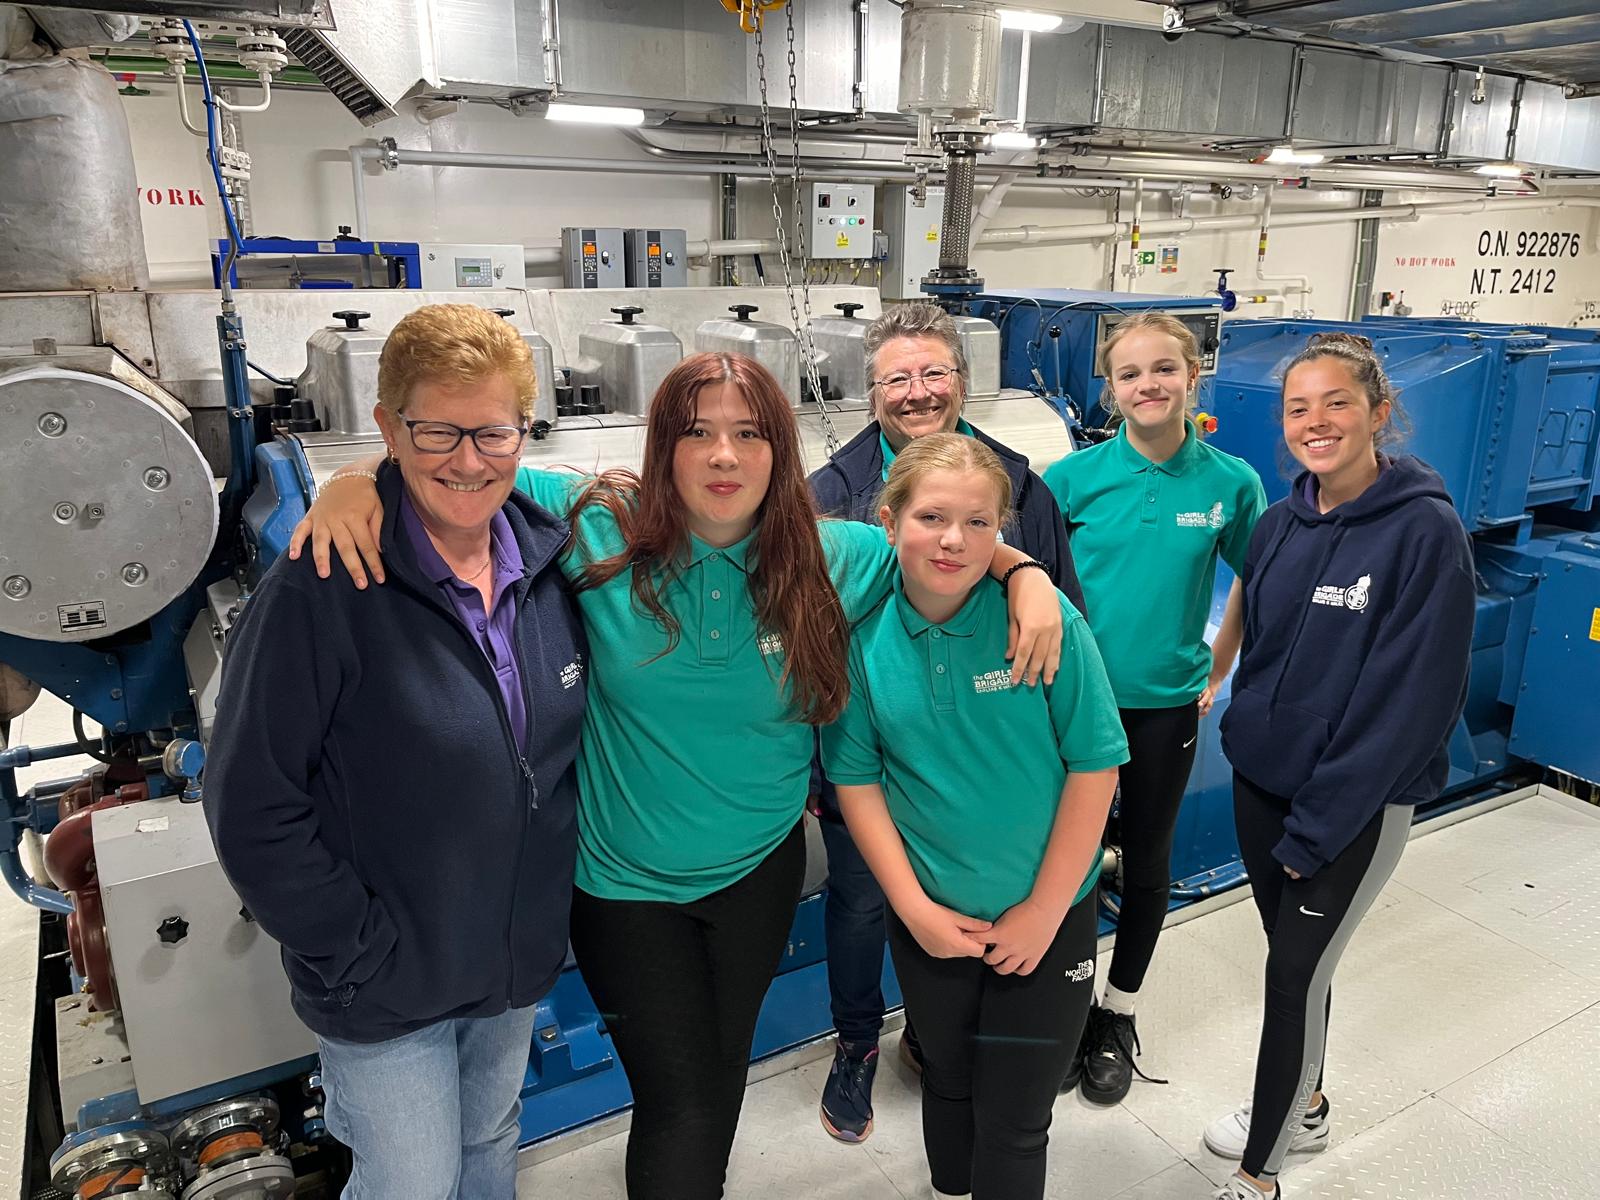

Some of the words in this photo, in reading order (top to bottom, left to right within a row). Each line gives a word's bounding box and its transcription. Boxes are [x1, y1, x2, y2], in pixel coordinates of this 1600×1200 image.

[1478, 230, 1509, 257] O.N.
[1516, 231, 1581, 258] 922876
[1396, 257, 1406, 267] NO
[1409, 257, 1428, 267] HOT
[1431, 257, 1456, 267] WORK
[1470, 268, 1503, 295] N.T.
[1510, 268, 1556, 294] 2412
[974, 676, 1013, 688] BRIGAD
[1077, 961, 1089, 969] THE
[1065, 968, 1088, 977] NORTH
[1072, 974, 1088, 982] FACE
